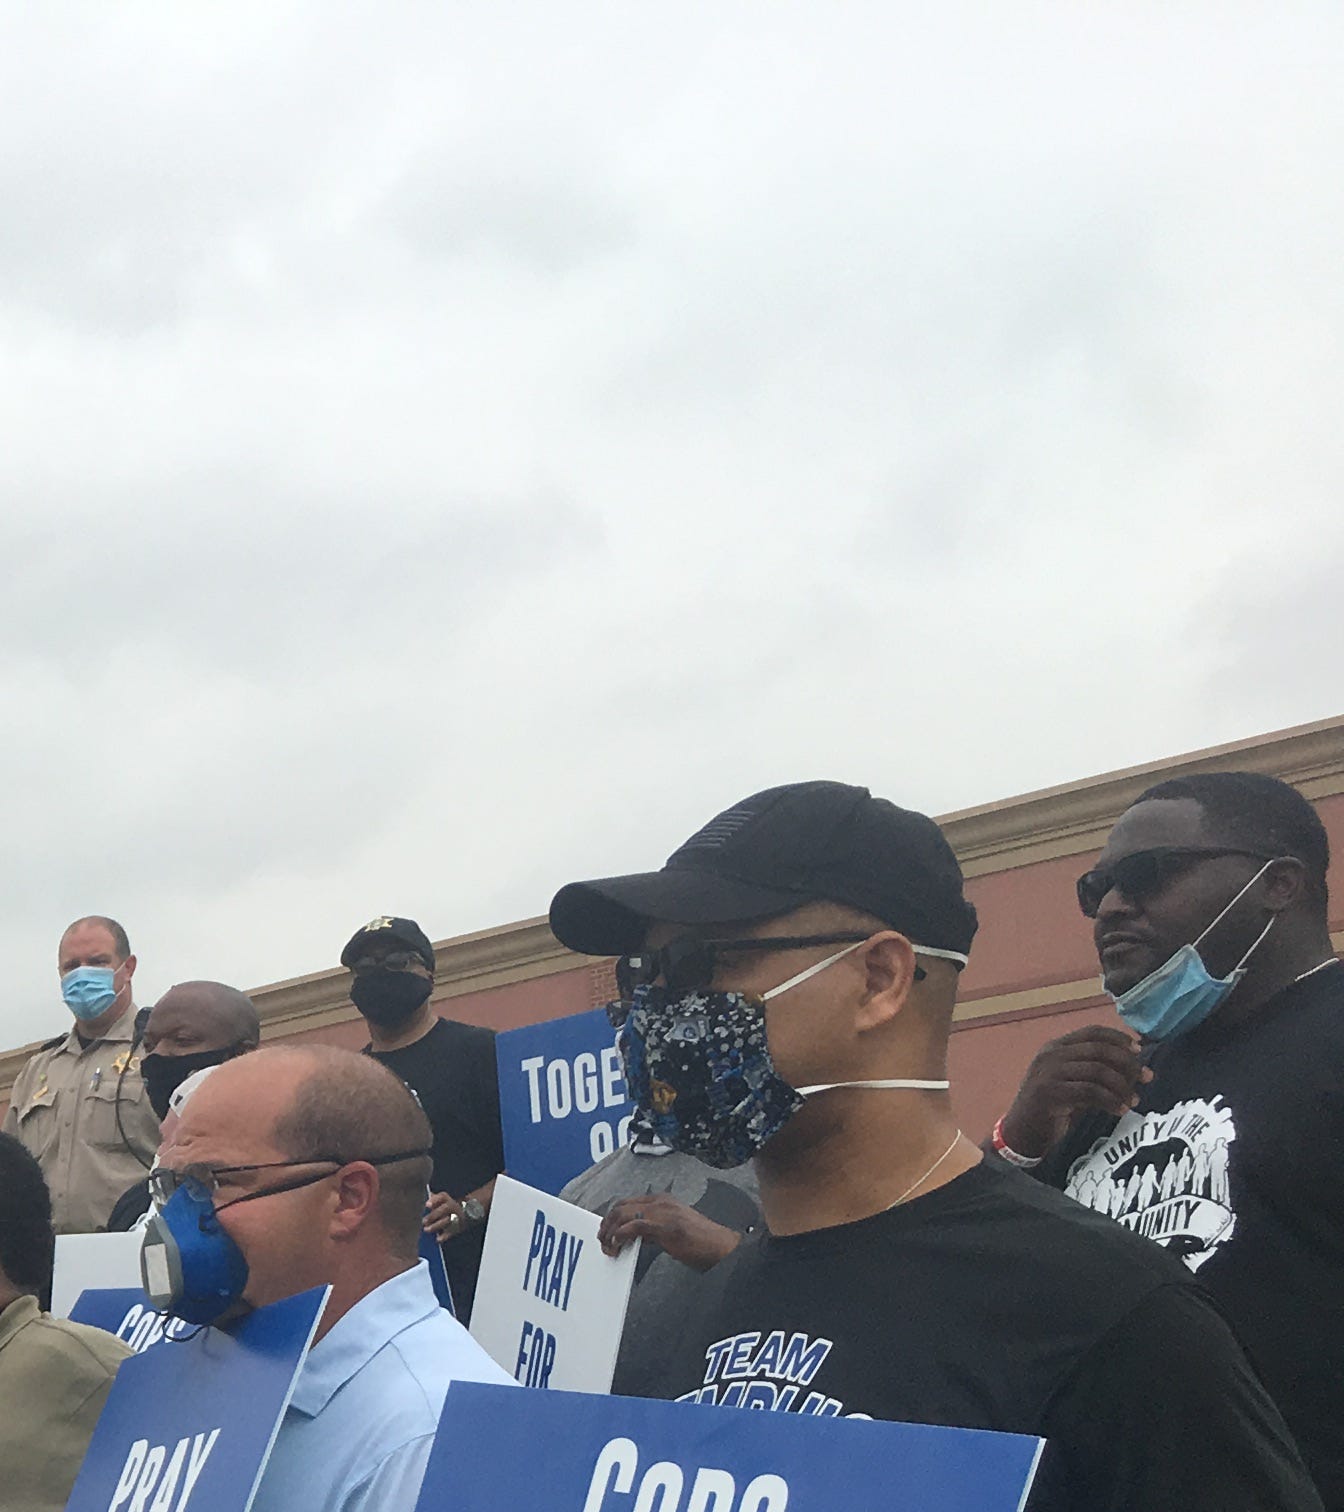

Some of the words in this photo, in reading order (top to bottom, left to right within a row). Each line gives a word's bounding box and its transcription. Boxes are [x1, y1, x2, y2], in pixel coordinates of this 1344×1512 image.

[520, 1046, 625, 1124] TOGE
[1103, 1120, 1167, 1166] UNITY
[1134, 1199, 1202, 1237] UNITY
[522, 1208, 584, 1312] PRAY
[514, 1320, 557, 1389] FOR
[703, 1330, 834, 1386] TEAM
